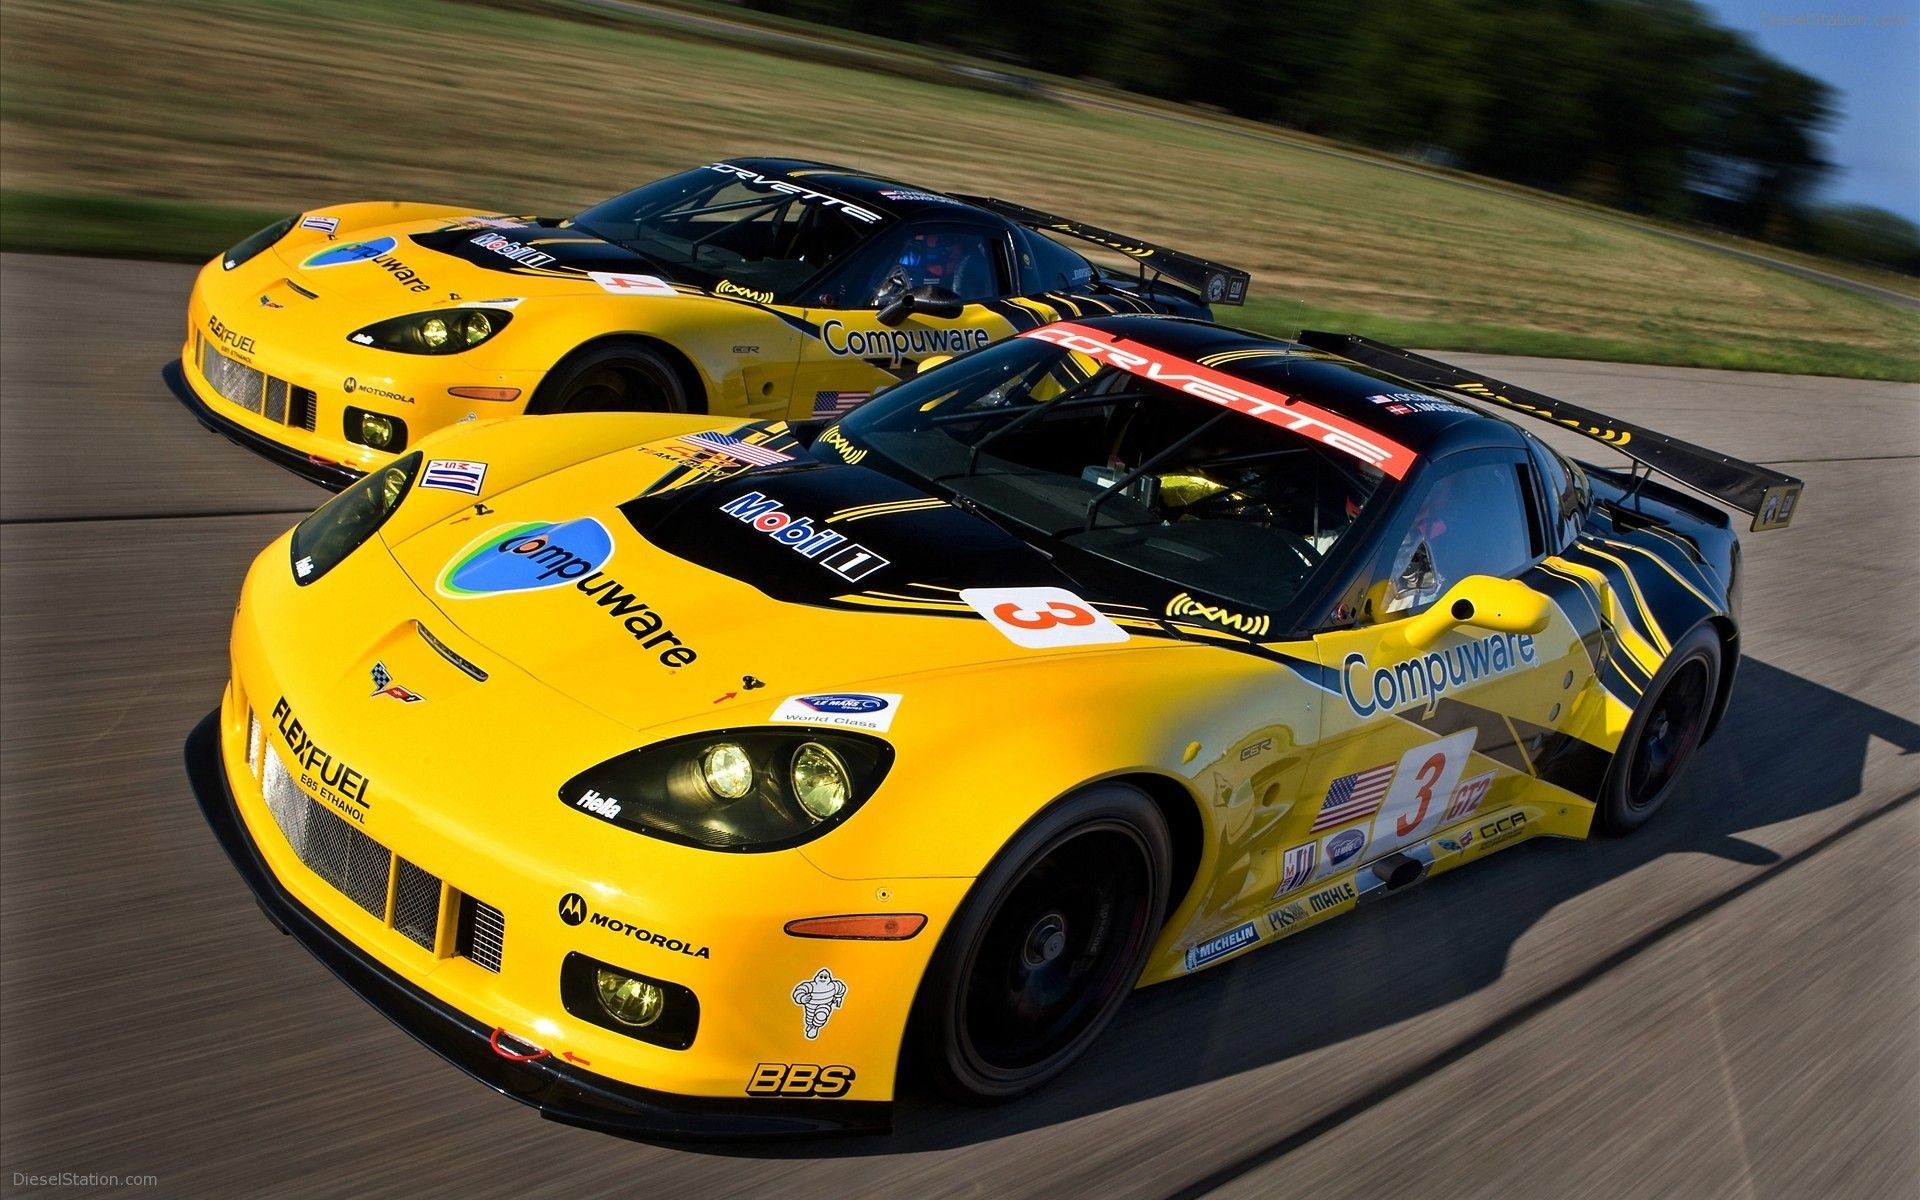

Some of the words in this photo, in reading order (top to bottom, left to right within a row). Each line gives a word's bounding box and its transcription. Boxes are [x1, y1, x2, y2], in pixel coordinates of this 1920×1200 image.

[470, 233, 536, 260] Mobil
[605, 277, 665, 289] 4
[823, 320, 989, 368] Compuware
[358, 385, 416, 405] MOTOROLA
[1030, 328, 1393, 465] CORVETTE
[719, 490, 848, 559] Mobil
[993, 601, 1097, 630] 3
[1343, 632, 1536, 719] Compuware
[785, 714, 829, 724] World
[834, 717, 877, 729] Class
[828, 699, 861, 708] MANS
[272, 695, 371, 810] FLEXFUEL
[300, 773, 319, 792] E85
[320, 786, 366, 825] ETHANOL
[576, 789, 622, 820] Hella
[1396, 752, 1446, 838] 3
[1446, 777, 1491, 821] GT2
[1309, 882, 1356, 912] MAHLE
[589, 912, 711, 960] MOTOROLA
[1199, 925, 1254, 959] MICHELIN
[745, 1062, 857, 1098] BBS
